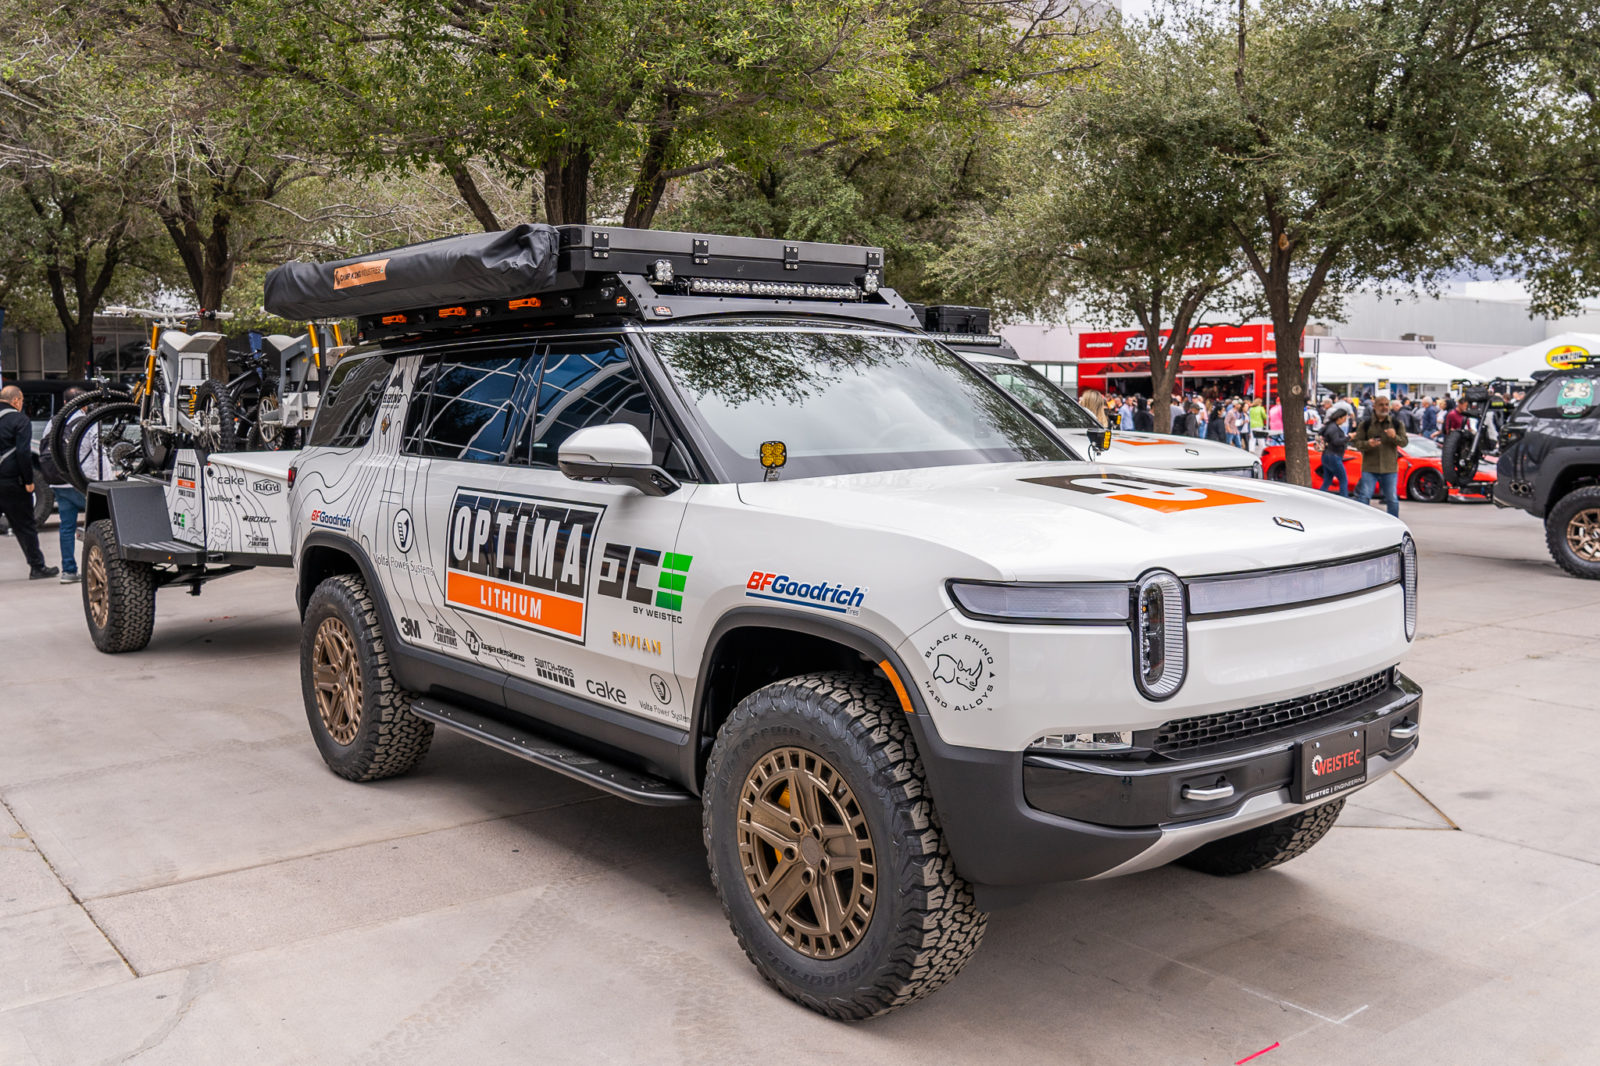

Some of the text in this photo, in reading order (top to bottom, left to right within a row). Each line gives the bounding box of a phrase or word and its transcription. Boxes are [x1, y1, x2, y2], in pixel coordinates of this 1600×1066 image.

[217, 476, 244, 486] cake
[209, 494, 233, 502] wallbox
[311, 510, 351, 528] BFGoodrich
[453, 506, 584, 585] OPTIMA
[373, 552, 434, 576] Volta Power Systems
[746, 571, 865, 608] BFGoodrich
[480, 584, 542, 620] LITHIUM
[632, 606, 683, 624] BY WEISTEC
[400, 616, 422, 639] 3M
[437, 634, 458, 647] SOLUTIONS
[481, 641, 496, 653] baja
[496, 648, 525, 662] designs
[612, 630, 662, 656] RIVIAN
[924, 633, 994, 665] BLACK RHINO
[534, 658, 575, 678] SWITCH-PROS
[586, 679, 627, 705] cake
[925, 681, 994, 712] HARD ALLOYS
[639, 700, 653, 712] Volta
[654, 704, 670, 716] Power
[1315, 749, 1361, 776] WEISTEC
[1305, 788, 1330, 800] WEISTEC
